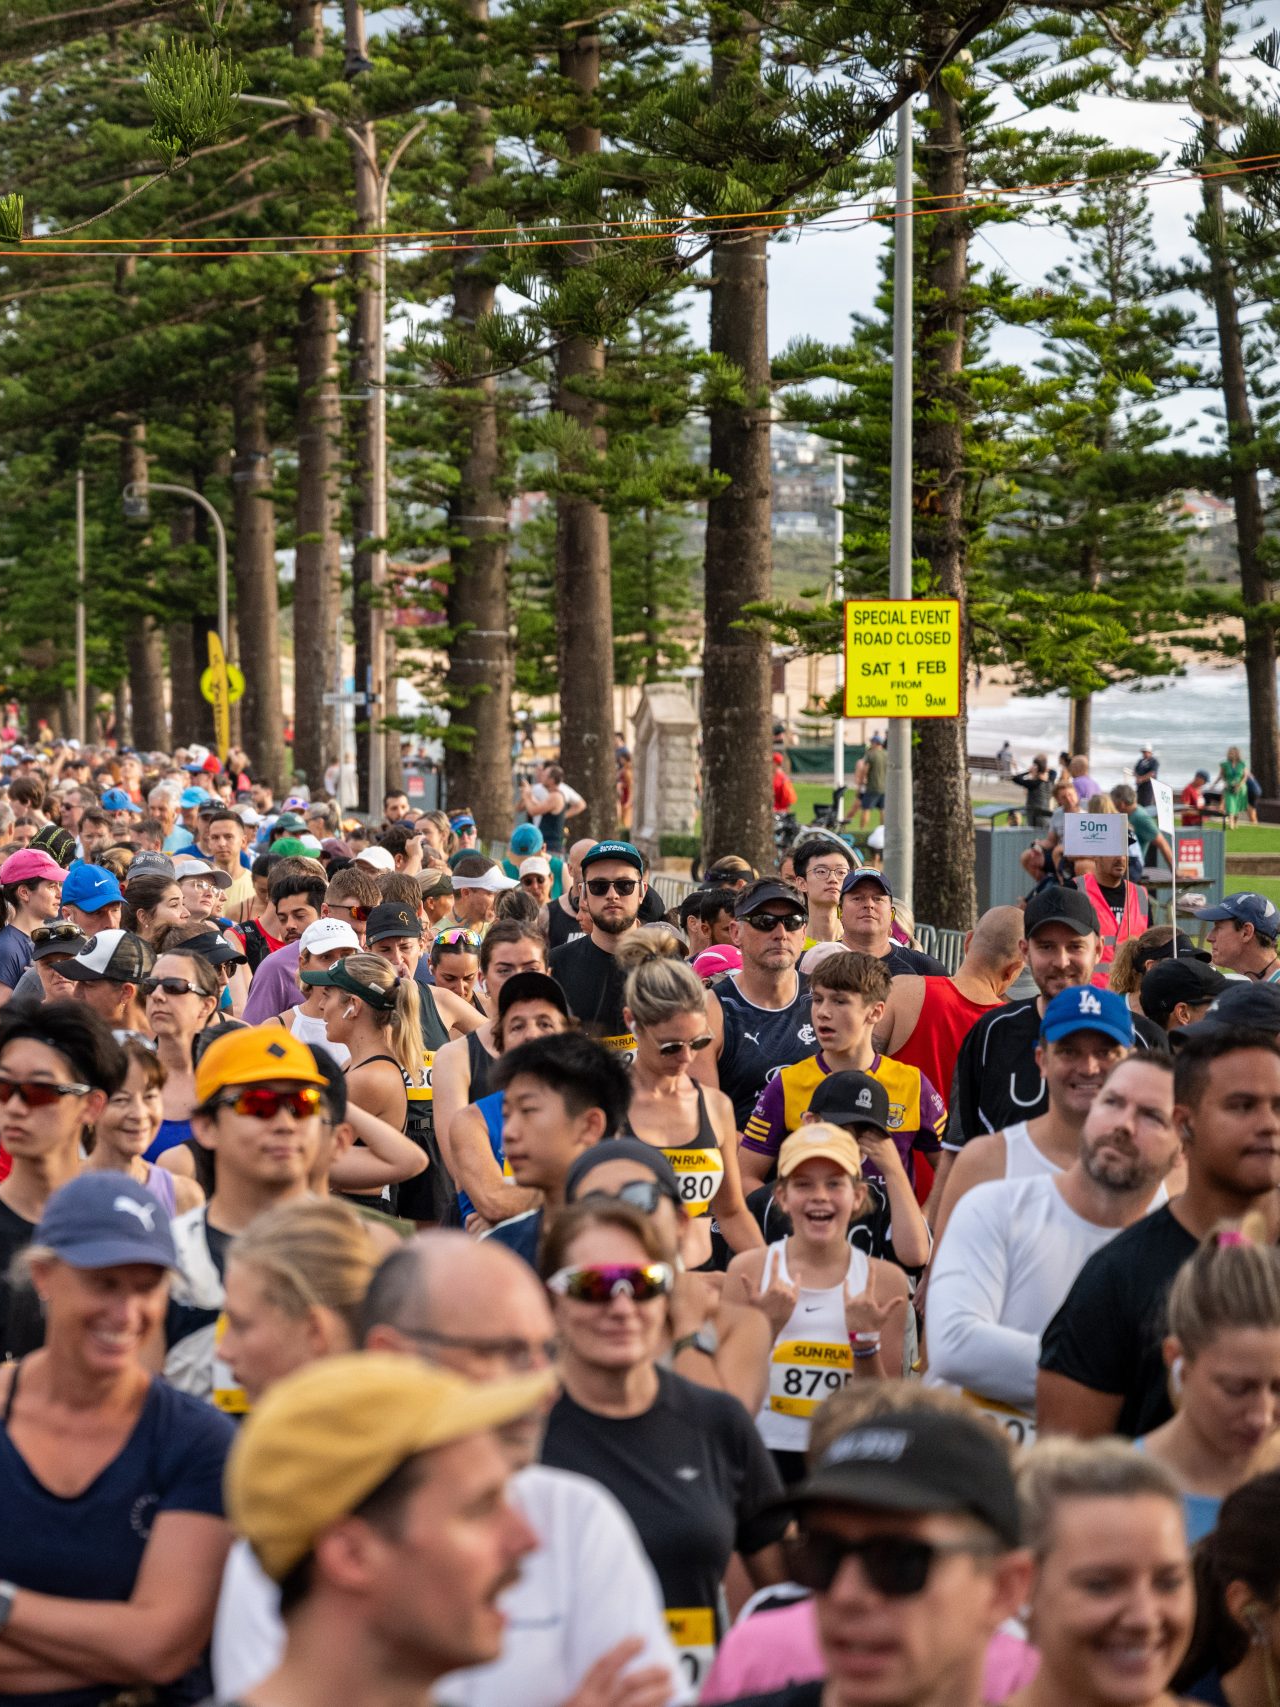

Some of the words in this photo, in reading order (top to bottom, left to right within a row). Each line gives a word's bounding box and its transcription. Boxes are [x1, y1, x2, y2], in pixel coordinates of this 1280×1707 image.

[854, 610, 907, 625] SPECIAL
[910, 610, 951, 625] EVENT
[854, 631, 893, 645] ROAD
[896, 631, 951, 645] CLOSED
[861, 662, 891, 677] SAT
[898, 661, 906, 675] 1
[917, 660, 947, 675] FEB
[890, 680, 922, 689] FROM
[895, 694, 908, 707] TO
[1079, 820, 1108, 832] 50m
[1078, 990, 1101, 1015] LA
[683, 1155, 706, 1165] RUN
[675, 1175, 713, 1200] 80
[793, 1345, 823, 1358] SUN
[824, 1347, 849, 1360] RUN
